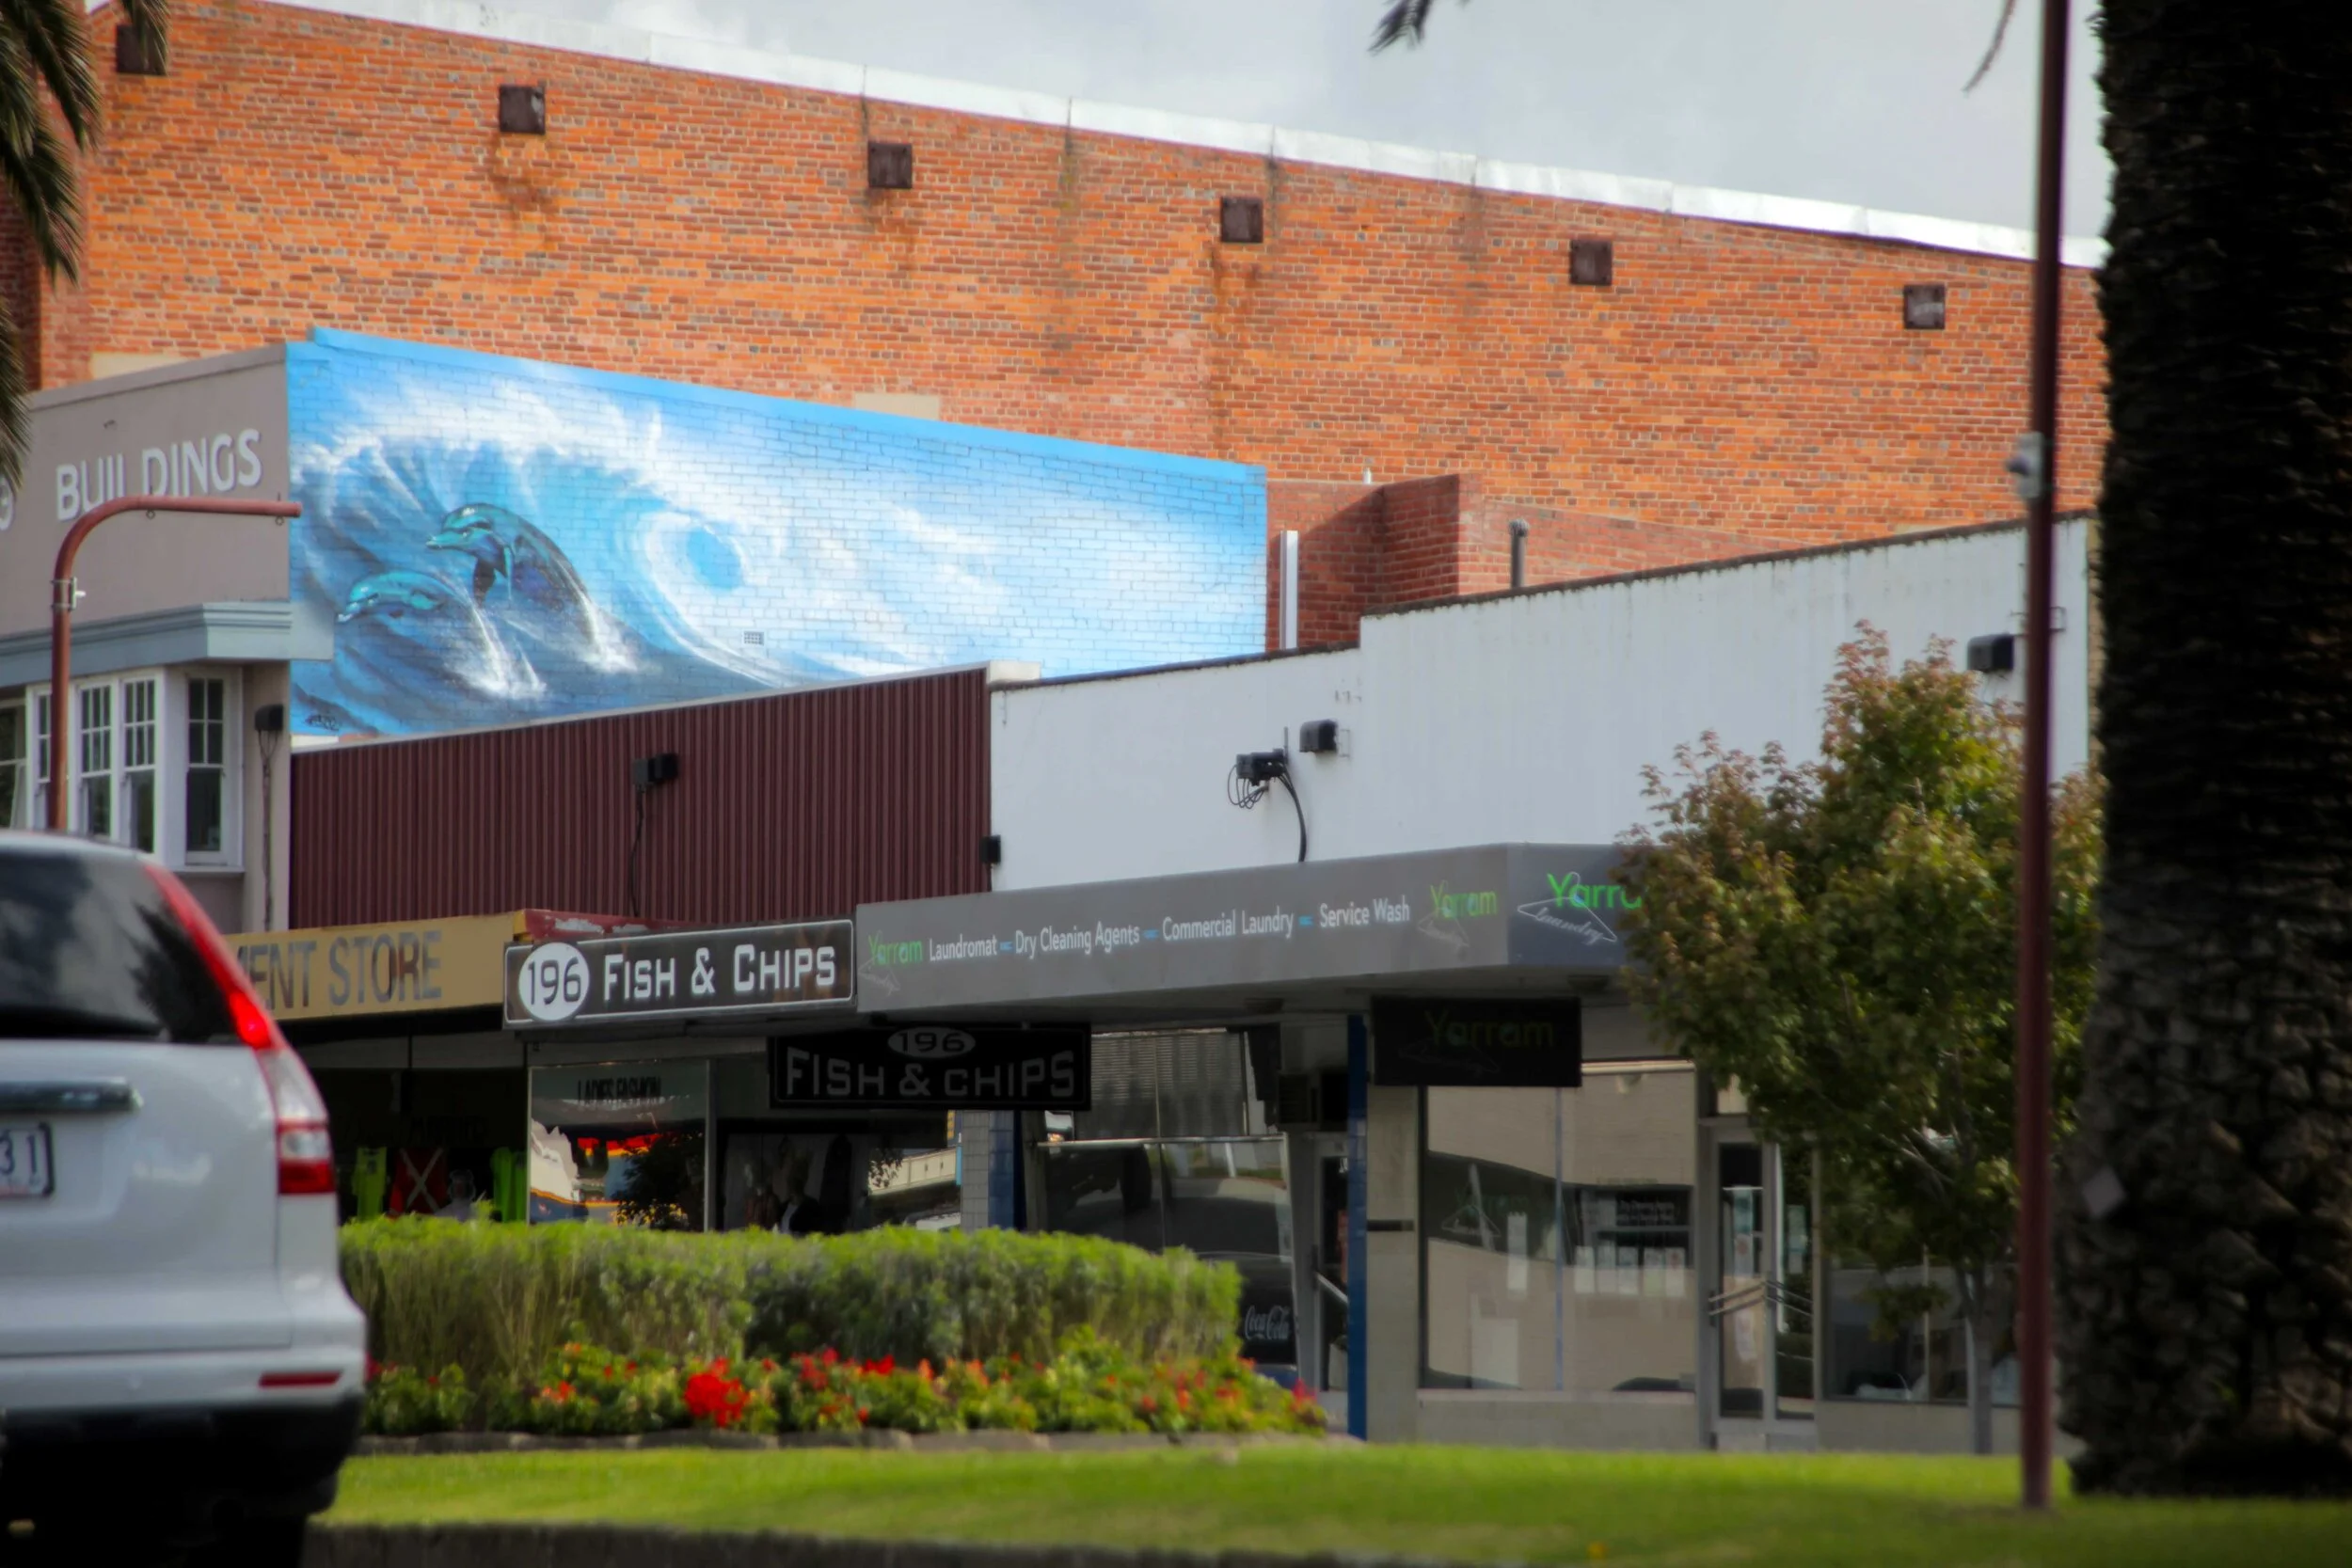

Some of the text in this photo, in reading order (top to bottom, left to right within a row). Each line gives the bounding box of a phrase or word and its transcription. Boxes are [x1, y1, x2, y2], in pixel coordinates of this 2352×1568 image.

[1430, 885, 1498, 919] Yarram
[867, 895, 1410, 965] Yarram Laundromat Dry Cleaning Agents Commercial Laundry Service Wash
[329, 931, 441, 1006] STORE
[528, 955, 581, 1006] 196
[691, 947, 716, 994] &
[900, 1031, 966, 1054] 196
[1425, 1010, 1554, 1047] Yarram
[787, 1046, 1074, 1097] FISH & CHIPS
